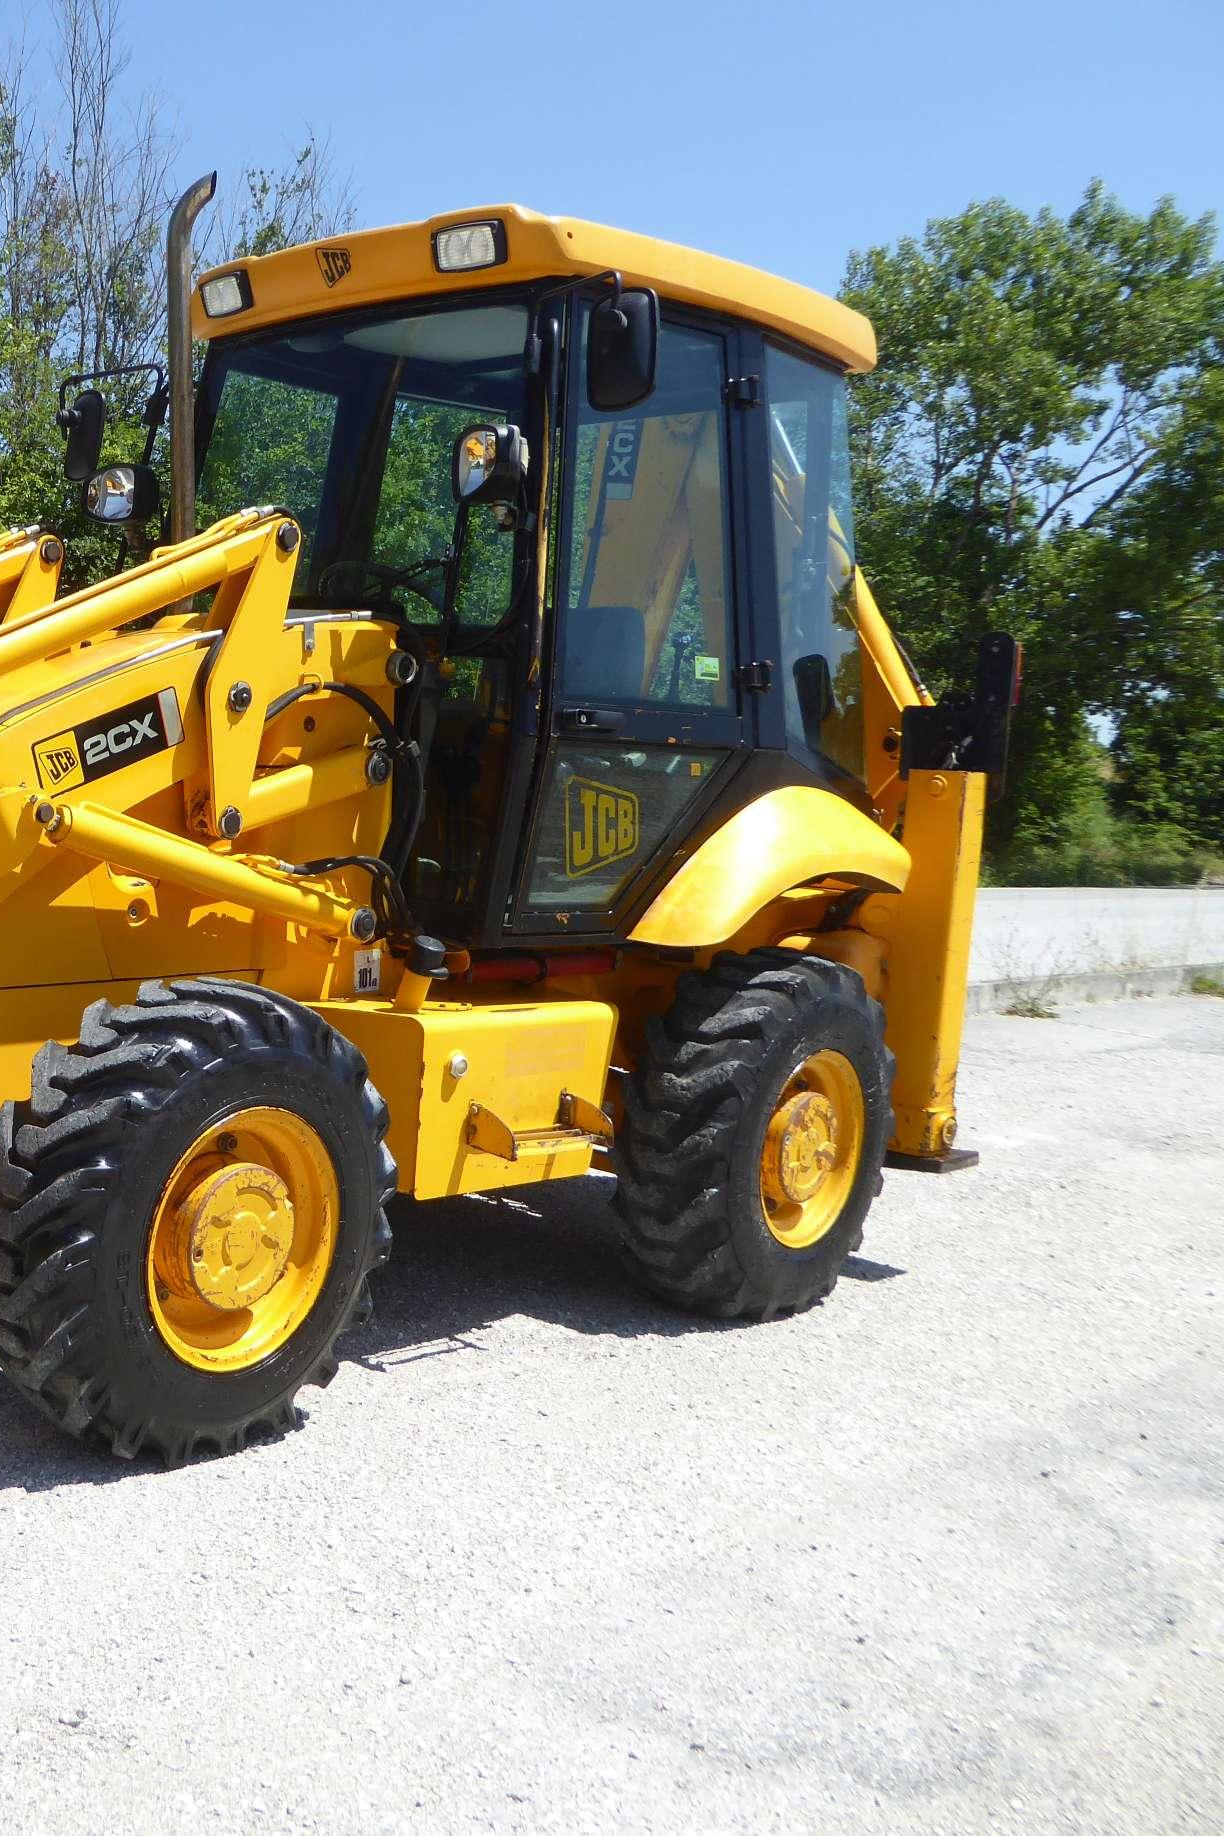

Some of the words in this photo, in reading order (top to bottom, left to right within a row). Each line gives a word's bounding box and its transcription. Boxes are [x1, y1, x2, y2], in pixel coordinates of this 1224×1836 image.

[321, 251, 351, 283] JCB
[46, 750, 76, 781] JCB
[83, 711, 159, 766] 2CX
[572, 787, 634, 866] JCB
